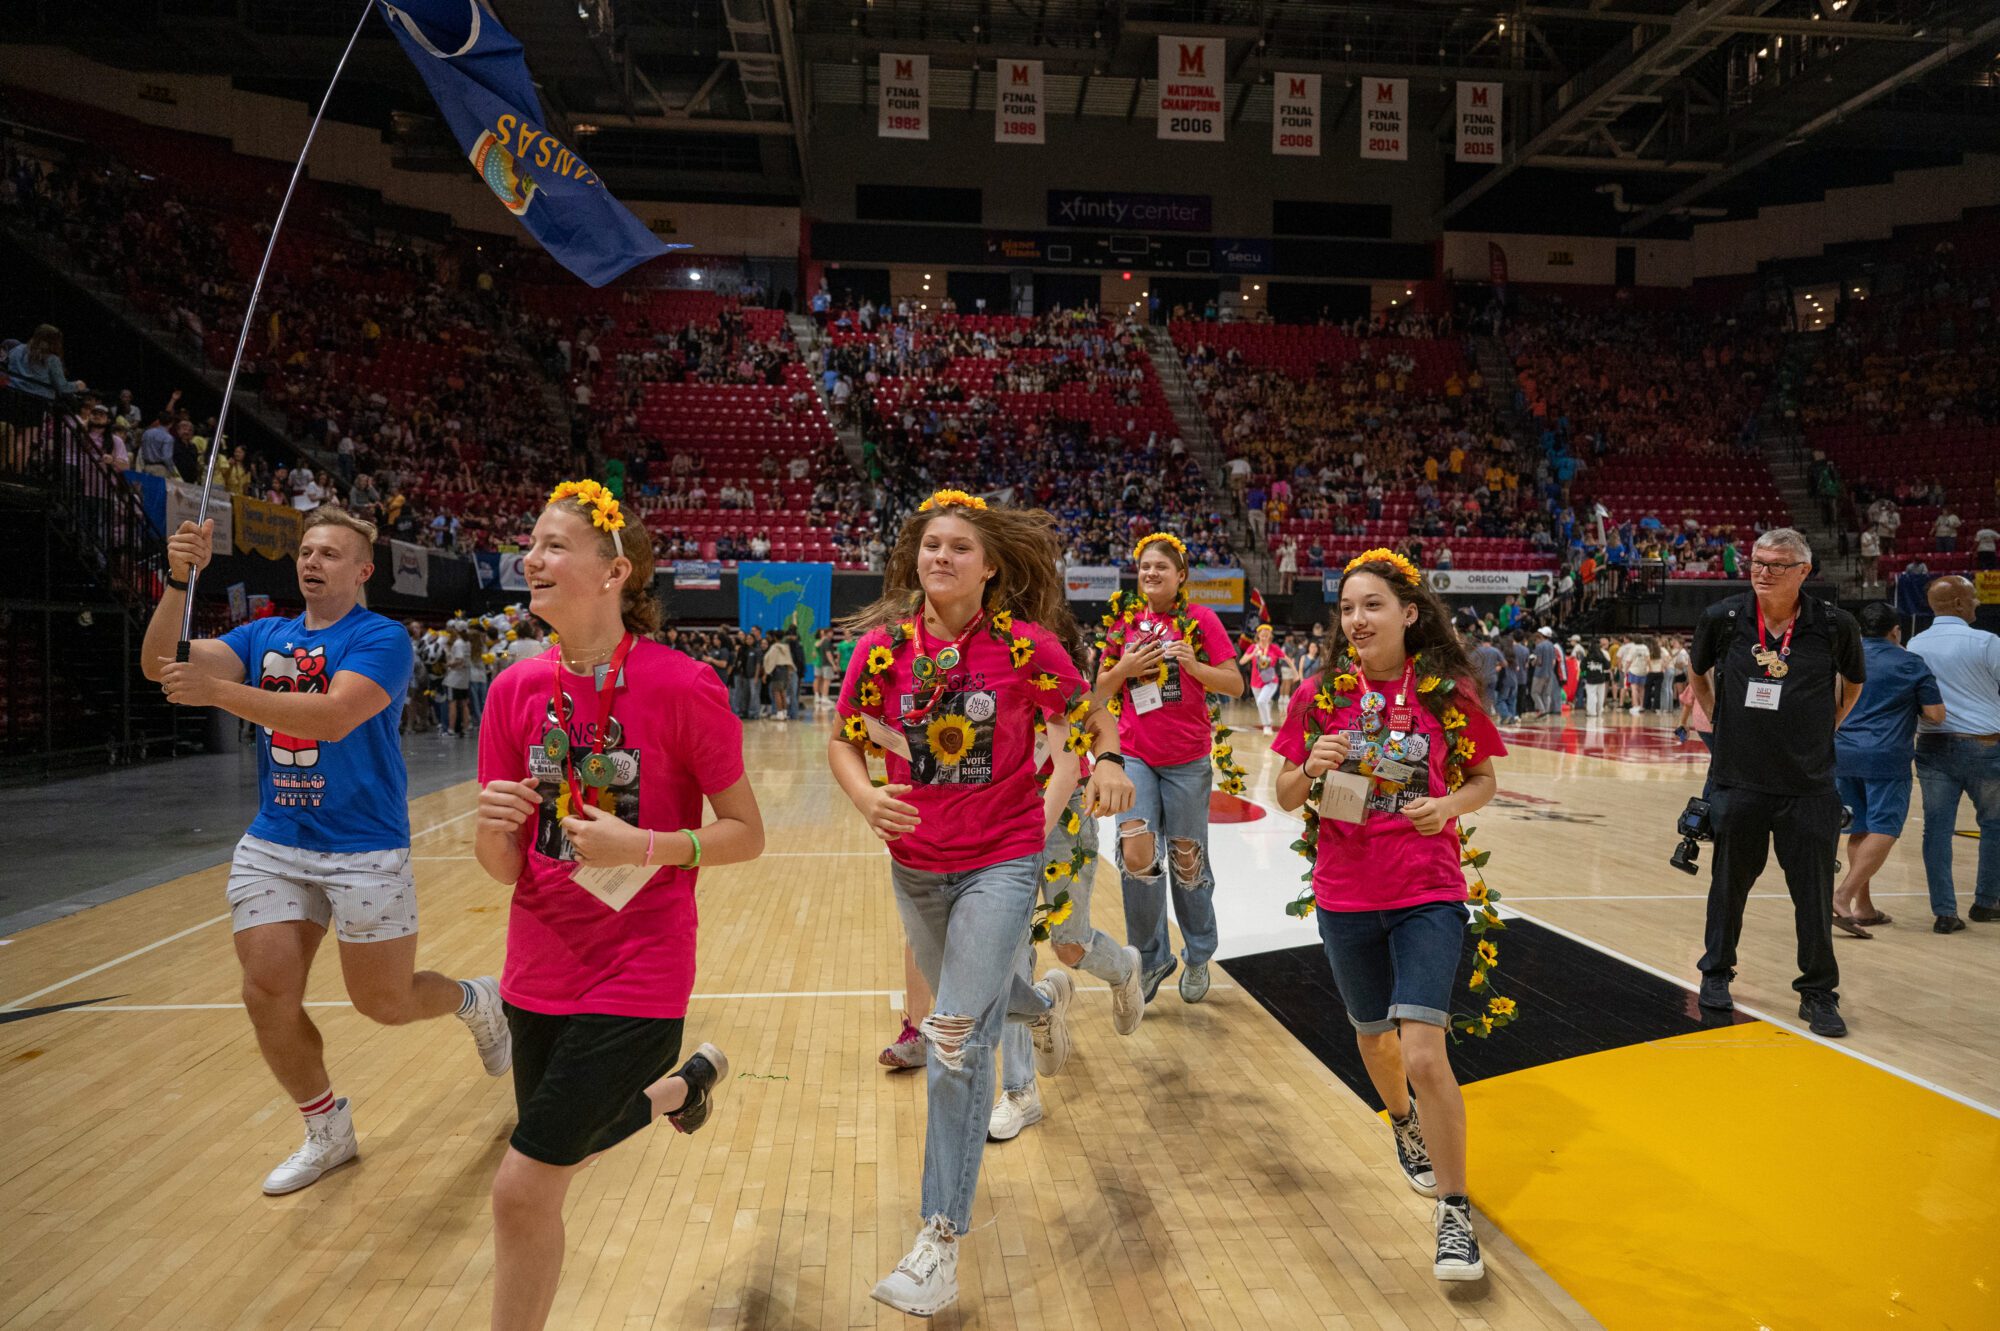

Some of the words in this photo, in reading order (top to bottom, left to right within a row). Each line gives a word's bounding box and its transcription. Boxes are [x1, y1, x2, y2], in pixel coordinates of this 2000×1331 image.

[1178, 43, 1205, 73] M
[895, 59, 913, 78] M
[1011, 65, 1028, 84] M
[886, 87, 921, 98] FINAL
[1167, 84, 1216, 98] NATIONAL
[1290, 78, 1305, 97] M
[1377, 83, 1393, 101] M
[1002, 92, 1038, 103] FINAL
[1472, 87, 1488, 105] M
[887, 98, 920, 109] FOUR
[1004, 104, 1036, 115] FOUR
[1161, 98, 1221, 113] CHAMPIONS
[1280, 105, 1314, 116] FINAL
[1368, 110, 1402, 121] FINAL
[887, 115, 921, 130] 1982
[1281, 117, 1312, 127] FOUR
[1462, 113, 1496, 124] FINAL
[1170, 118, 1212, 133] 2006
[1369, 121, 1400, 132] FOUR
[1464, 125, 1494, 136] FOUR
[497, 113, 597, 185] ANSAS
[1369, 138, 1400, 152] 2014
[1464, 142, 1495, 155] 2015
[1060, 196, 1130, 223] xfinity
[1132, 200, 1201, 221] center
[1468, 575, 1509, 583] OREGON
[1188, 589, 1232, 600] IFORNIA
[912, 672, 985, 692] KSAS
[972, 697, 990, 708] NHD
[968, 704, 989, 716] 2025
[1407, 737, 1424, 750] NHD
[1407, 747, 1422, 758] 025
[966, 757, 986, 765] VOTE
[962, 766, 991, 775] RIGHTS
[272, 772, 326, 789] HELLO
